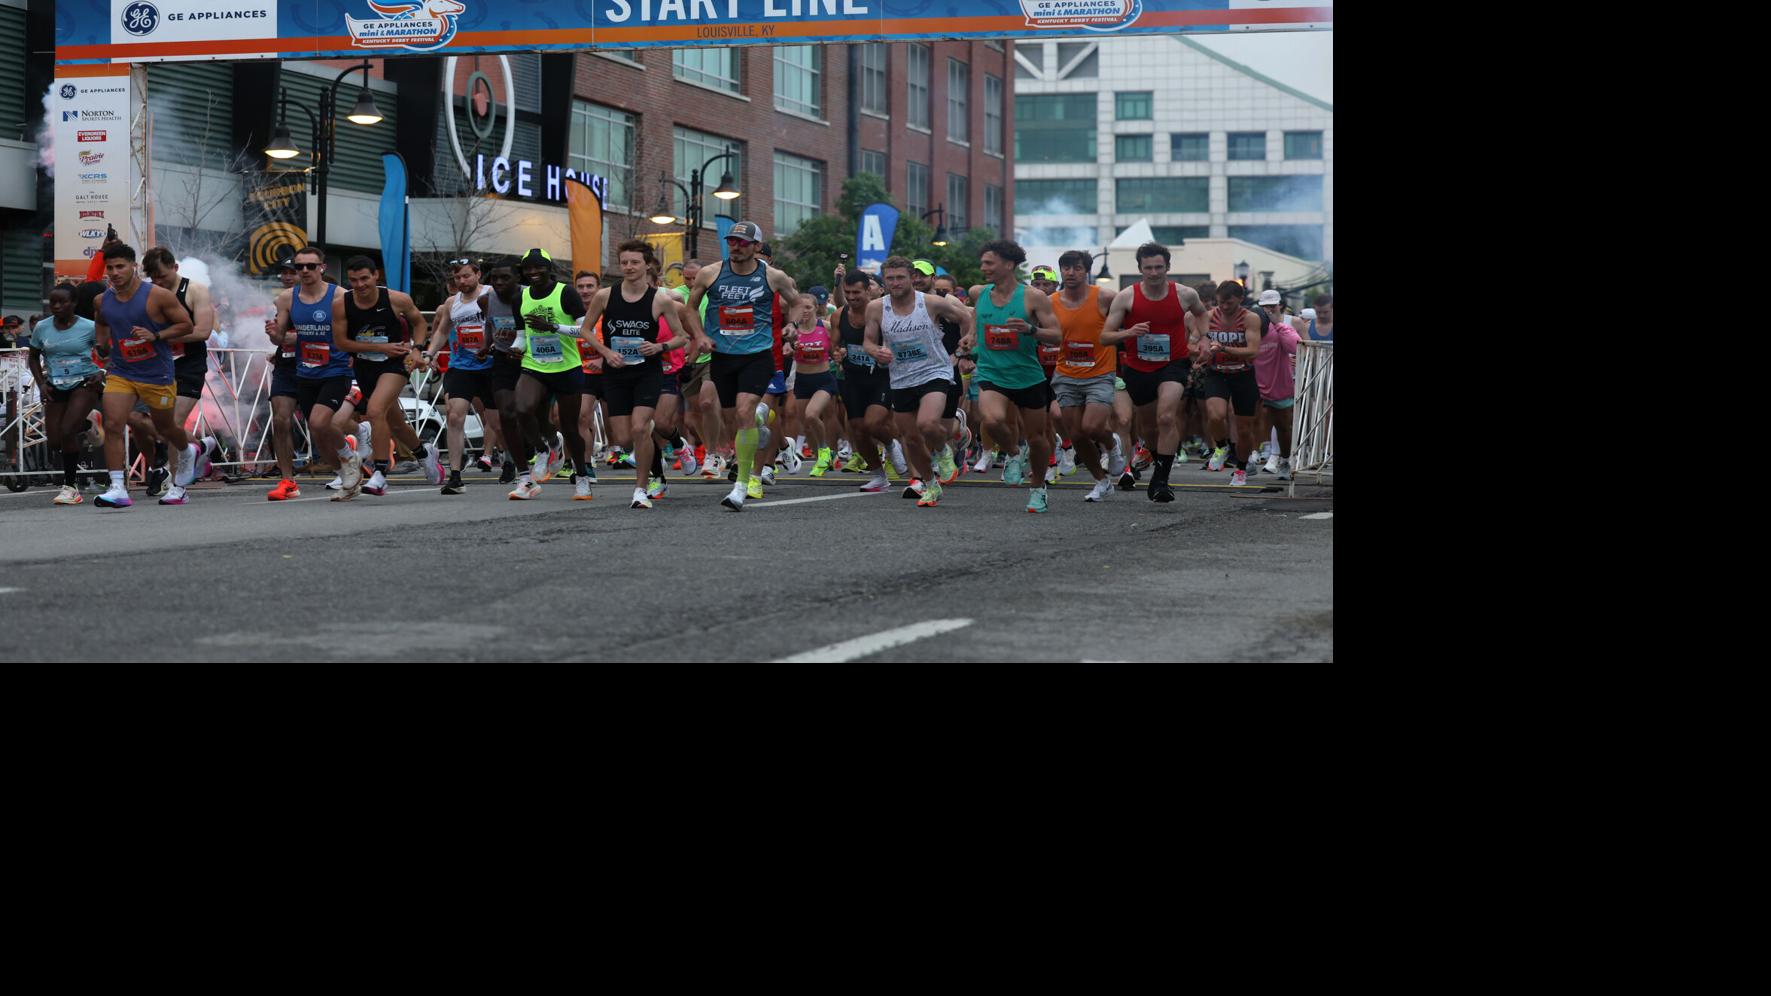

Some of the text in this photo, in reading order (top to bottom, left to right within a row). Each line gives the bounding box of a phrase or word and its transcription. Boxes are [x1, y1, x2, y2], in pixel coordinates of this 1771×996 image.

[1054, 0, 1116, 8] APPLIANCES
[168, 10, 267, 21] GE APPLIANCES
[1033, 9, 1055, 17] mini
[1063, 7, 1121, 16] MARATHON
[378, 21, 433, 29] APPLIANCES
[359, 29, 379, 37] mini
[386, 28, 437, 37] MARATHON
[697, 24, 776, 39] LOUISVILLE, KY
[477, 154, 533, 197] ICE
[863, 215, 886, 251] A
[718, 285, 751, 295] FLEET
[721, 292, 748, 300] FEET
[615, 319, 650, 330] SWAGS
[887, 319, 929, 334] Madison
[622, 328, 641, 336] ELITE
[1208, 331, 1246, 343] HOPE
